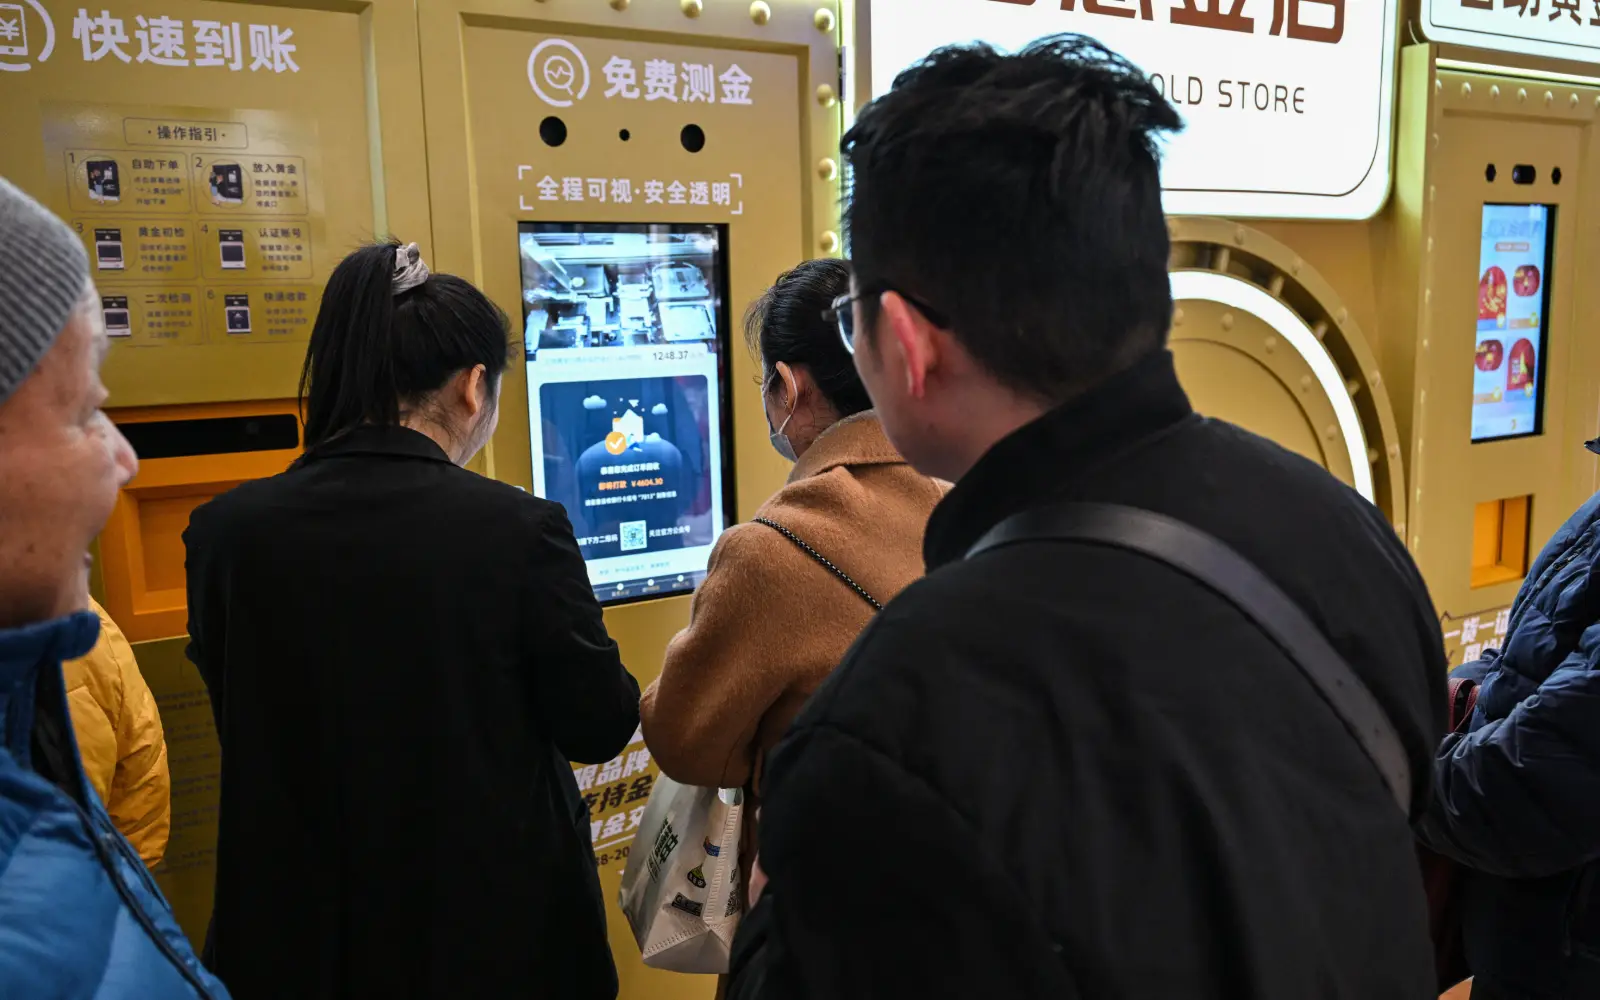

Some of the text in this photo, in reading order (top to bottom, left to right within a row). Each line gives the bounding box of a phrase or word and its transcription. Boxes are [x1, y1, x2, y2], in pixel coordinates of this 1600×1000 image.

[72, 8, 300, 73] 快速到账
[601, 55, 753, 105] 免费测金
[1218, 79, 1305, 114] STORE
[68, 152, 75, 164] 1
[132, 158, 179, 170] 自助下单
[195, 156, 203, 168] 2
[252, 161, 297, 174] 放入黄金
[536, 175, 732, 206] 全程可视·安全透明
[201, 224, 209, 234] 4
